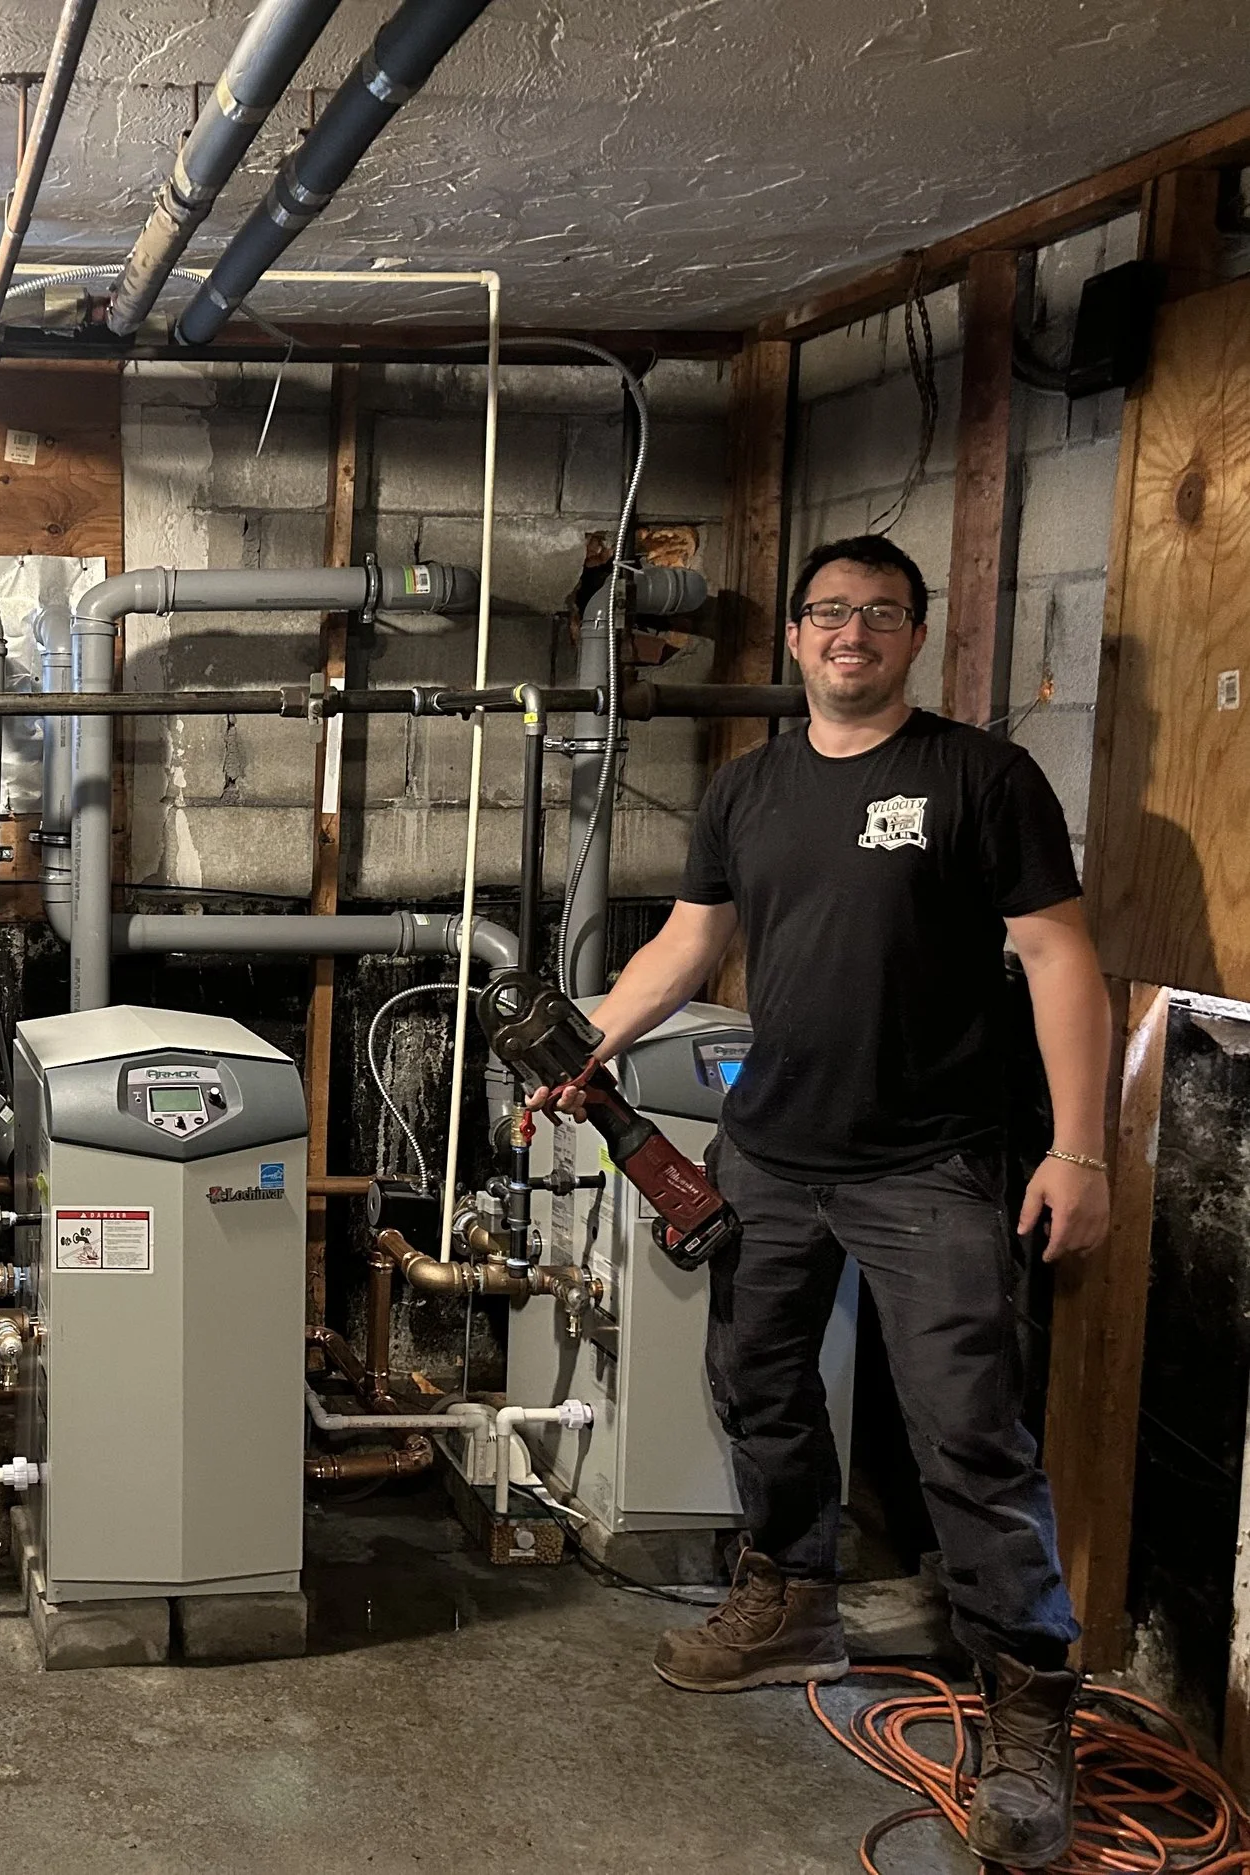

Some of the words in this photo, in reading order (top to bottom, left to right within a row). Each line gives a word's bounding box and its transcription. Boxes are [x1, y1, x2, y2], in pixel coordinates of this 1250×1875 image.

[871, 800, 924, 813] VELOCITY
[147, 1069, 200, 1079] ARMOR
[225, 1186, 284, 1201] Lochinvar
